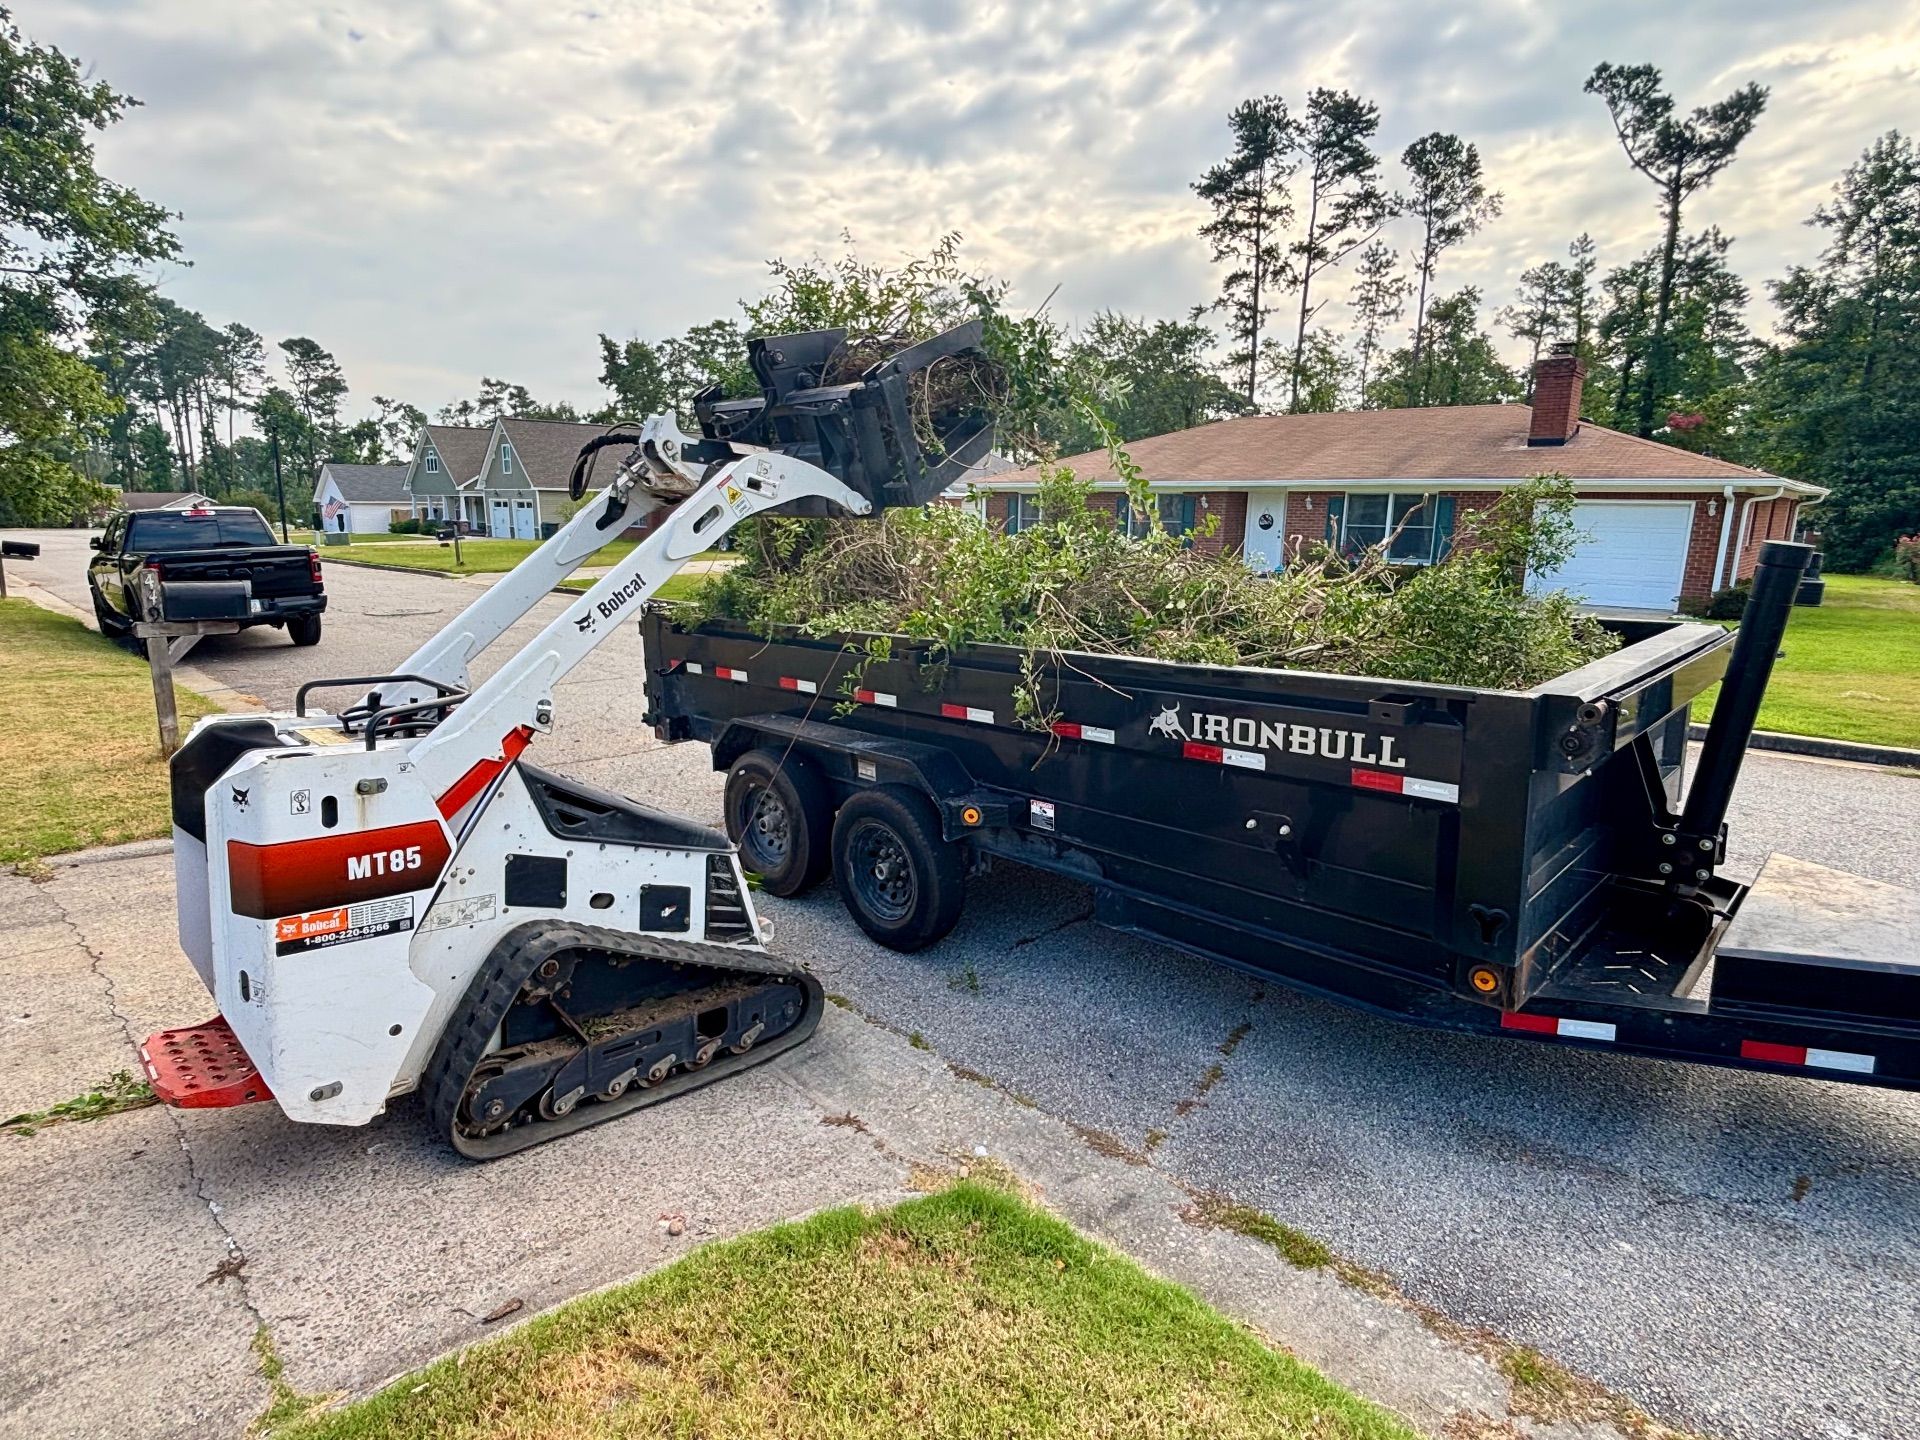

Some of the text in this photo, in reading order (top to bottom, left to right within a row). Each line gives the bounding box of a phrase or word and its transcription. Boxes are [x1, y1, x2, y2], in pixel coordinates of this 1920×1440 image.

[597, 572, 647, 619] Bobcat
[1191, 712, 1406, 767] IRONBULL
[347, 846, 421, 880] MT85
[301, 917, 341, 934] Bobcat
[303, 922, 390, 945] 1-800-220-6266
